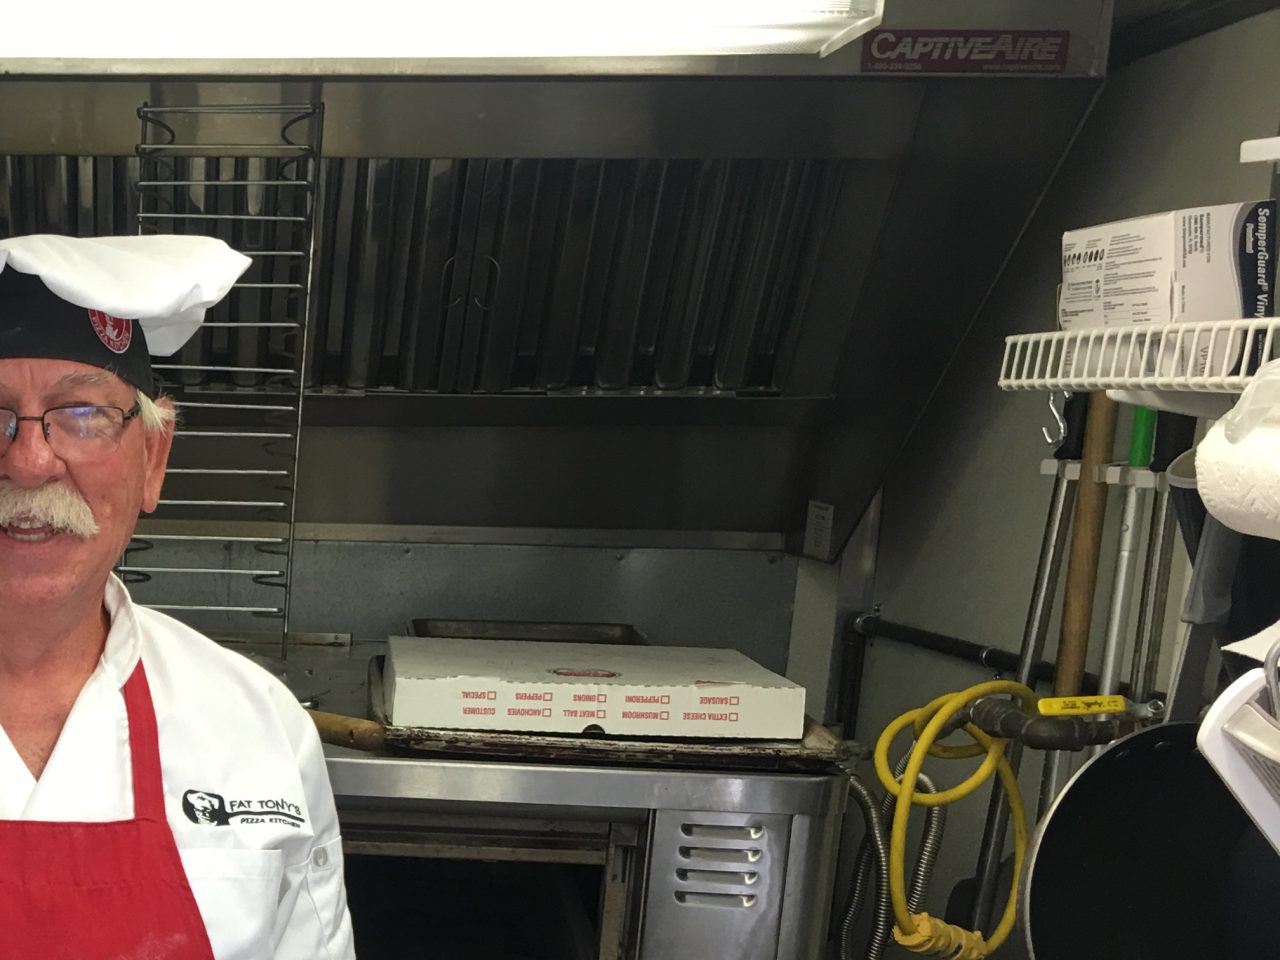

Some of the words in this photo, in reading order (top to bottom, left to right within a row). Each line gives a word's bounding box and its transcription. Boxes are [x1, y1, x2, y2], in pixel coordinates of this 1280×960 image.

[1254, 293, 1269, 319] Viny
[462, 691, 486, 699] SPECIAL
[515, 692, 543, 701] PEPPERS
[572, 694, 596, 702] ONIONS
[625, 695, 660, 704] PEPPERONI
[699, 696, 729, 705] SAUSAGE
[463, 707, 496, 715] CUSTOMER
[507, 708, 541, 716] ANCHOVIES
[563, 709, 578, 717] BALL
[579, 709, 596, 718] MEAT
[622, 711, 659, 719] MUSHROOM
[682, 712, 707, 720] CHEESE
[707, 713, 728, 721] EXTRA
[229, 799, 253, 812] FAT
[257, 798, 302, 816] TONY'S
[240, 817, 266, 825] PIZZA
[269, 818, 301, 828] KITCHEN
